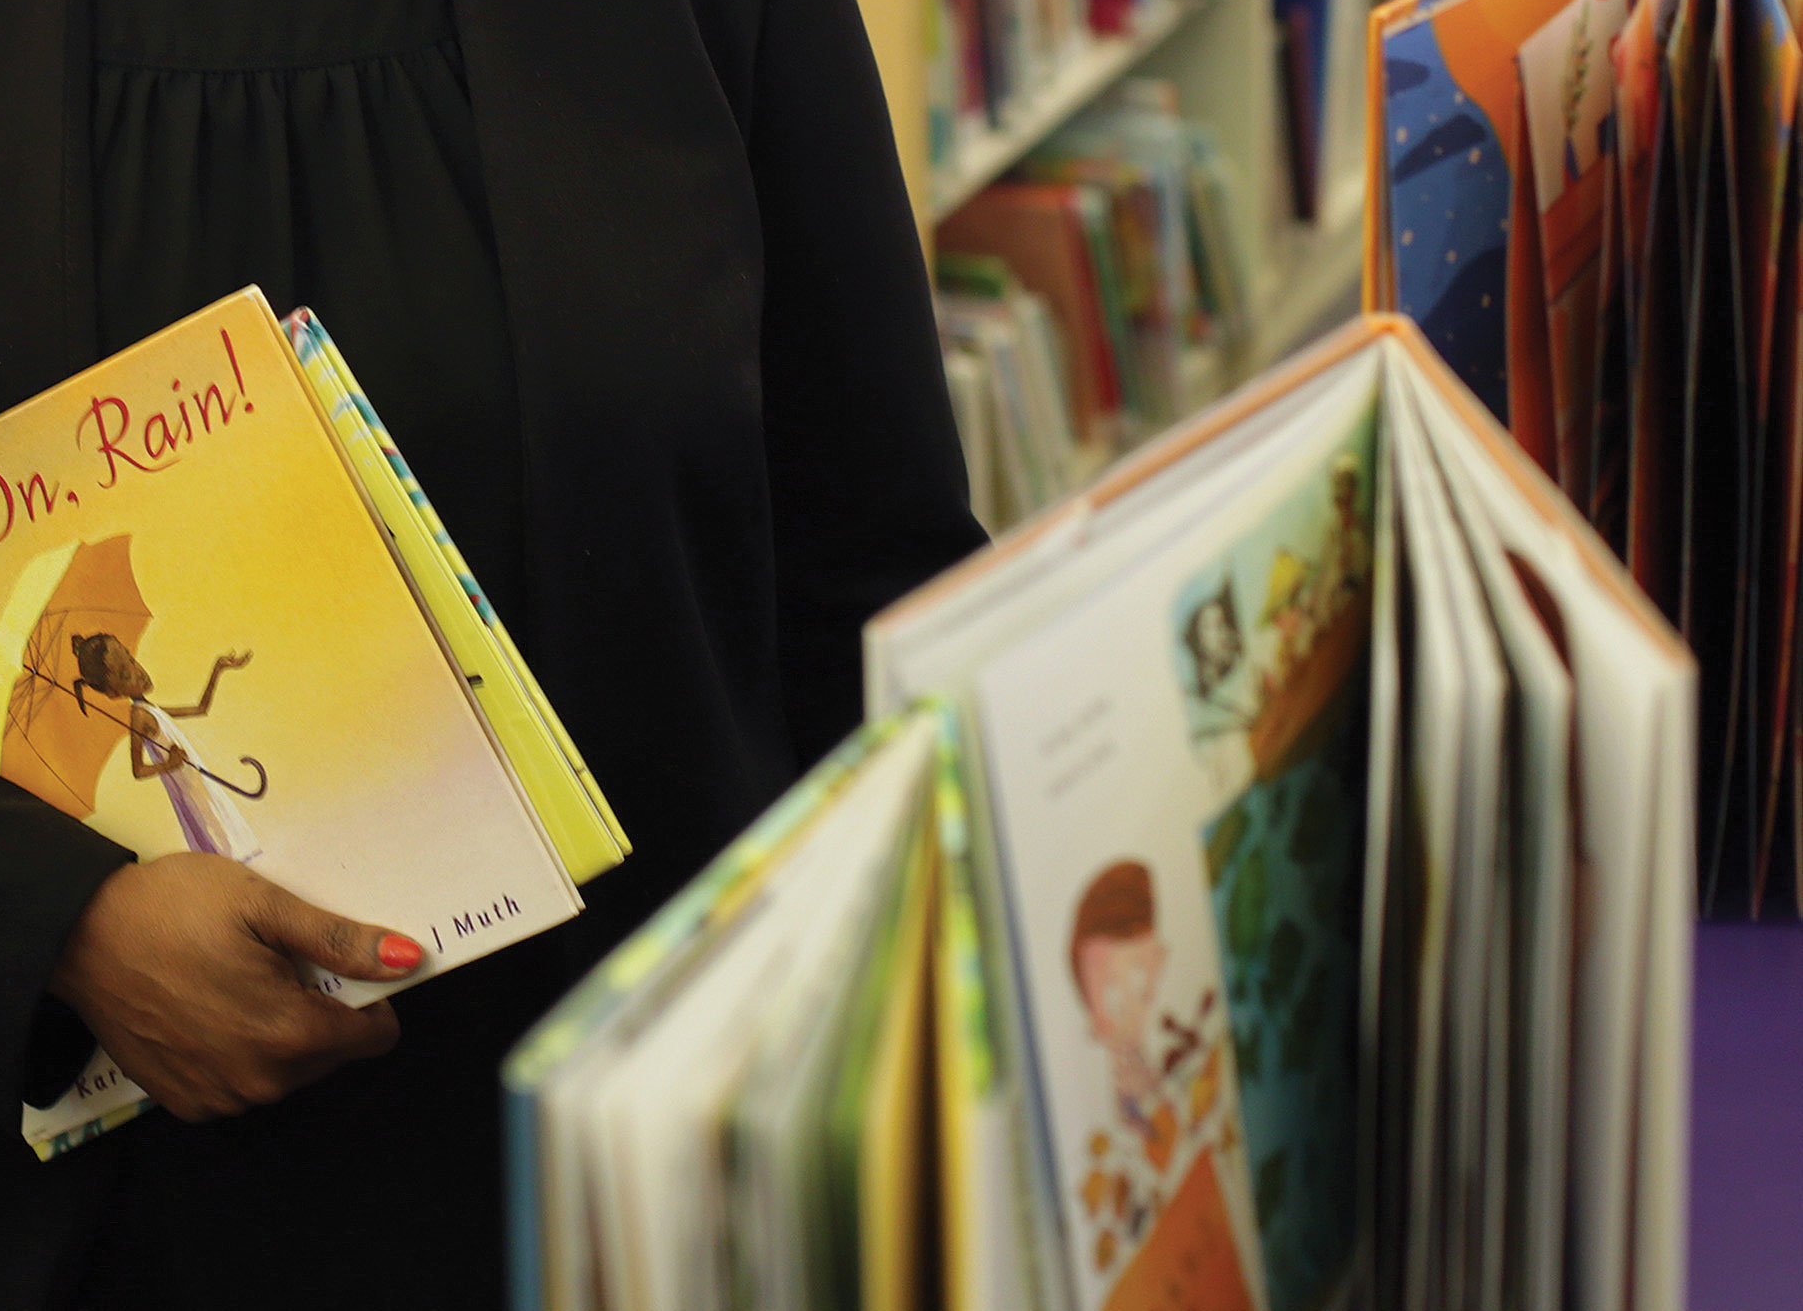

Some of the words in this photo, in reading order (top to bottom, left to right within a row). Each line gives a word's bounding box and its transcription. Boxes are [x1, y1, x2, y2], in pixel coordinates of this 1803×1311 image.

[76, 328, 254, 489] Rain!
[431, 924, 444, 954] J
[451, 893, 522, 939] Muth
[74, 1067, 117, 1100] Kar
